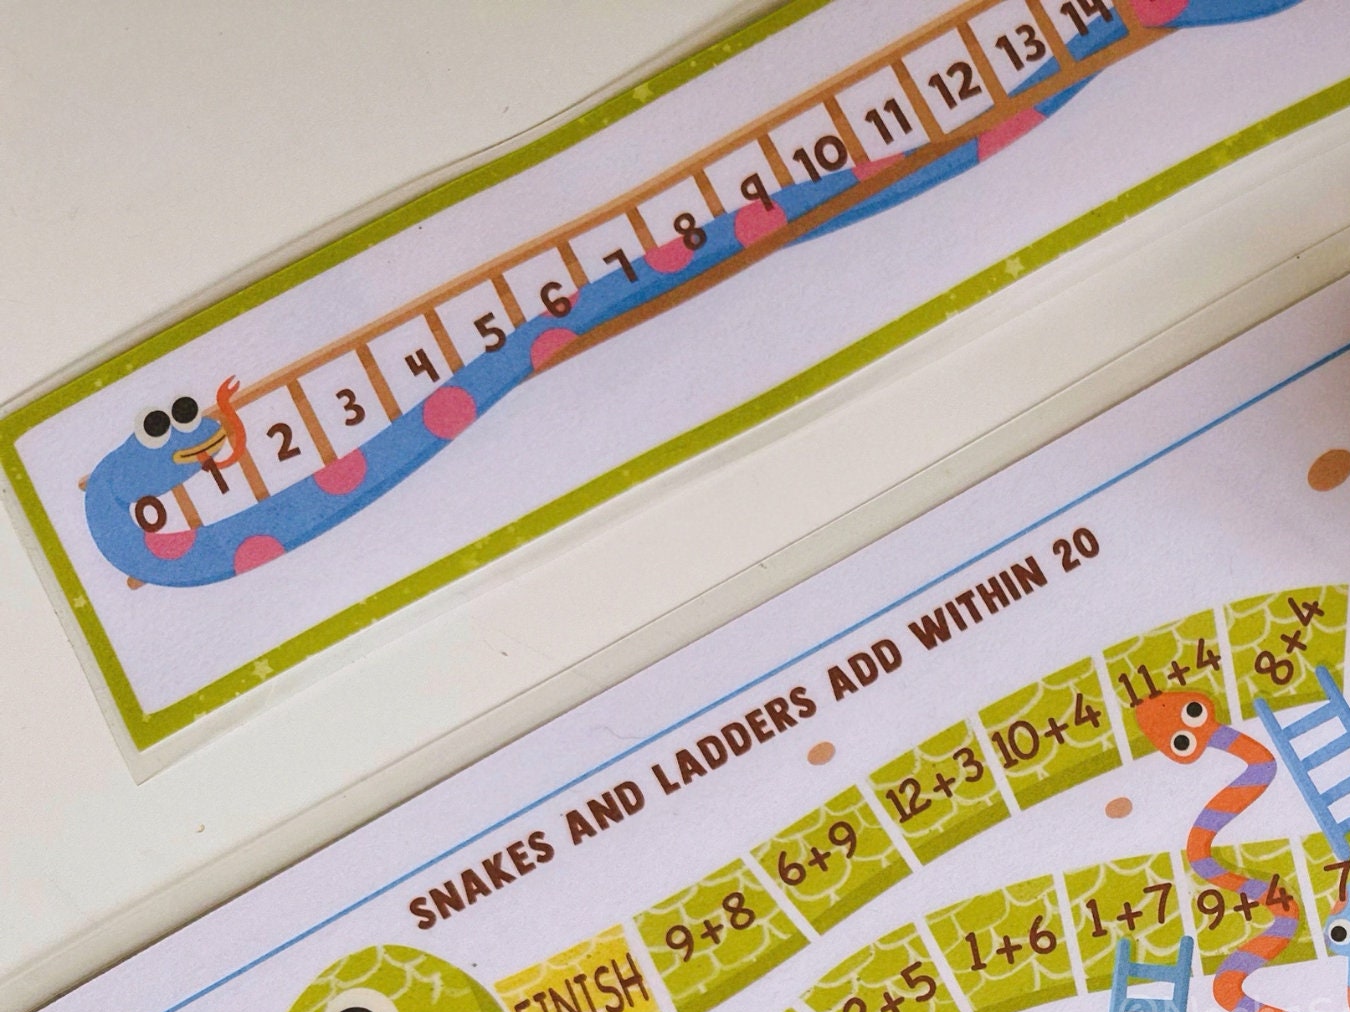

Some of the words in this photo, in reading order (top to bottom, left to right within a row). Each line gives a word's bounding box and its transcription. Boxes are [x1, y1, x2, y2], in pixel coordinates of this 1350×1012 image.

[135, 496, 166, 533] 0
[200, 456, 229, 494] 1
[267, 423, 300, 461] 2
[336, 389, 365, 425] 3
[405, 349, 439, 382] 4
[474, 312, 505, 351] 5
[541, 282, 572, 317] 6
[603, 249, 635, 280] 7
[674, 213, 705, 251] 8
[741, 173, 775, 212] 9
[793, 136, 847, 181] 10
[865, 98, 912, 144] 11
[929, 62, 981, 109] 12
[996, 20, 1048, 70] 13
[1119, 638, 1222, 708] 11+4
[1255, 598, 1324, 685] 8+4
[410, 832, 553, 929] SNAKES
[566, 782, 644, 845] AND
[652, 687, 816, 794] LADDERS
[828, 640, 901, 701] ADD
[908, 556, 1047, 650] WITHIN
[1053, 528, 1099, 572] 20
[992, 693, 1101, 768] 10+4
[886, 748, 983, 823] 12+3
[778, 822, 856, 885] 6+9
[666, 892, 755, 962] 9+8
[1086, 883, 1172, 937] 1+7
[1197, 874, 1293, 930] 9+4
[965, 915, 1056, 970] 1+6
